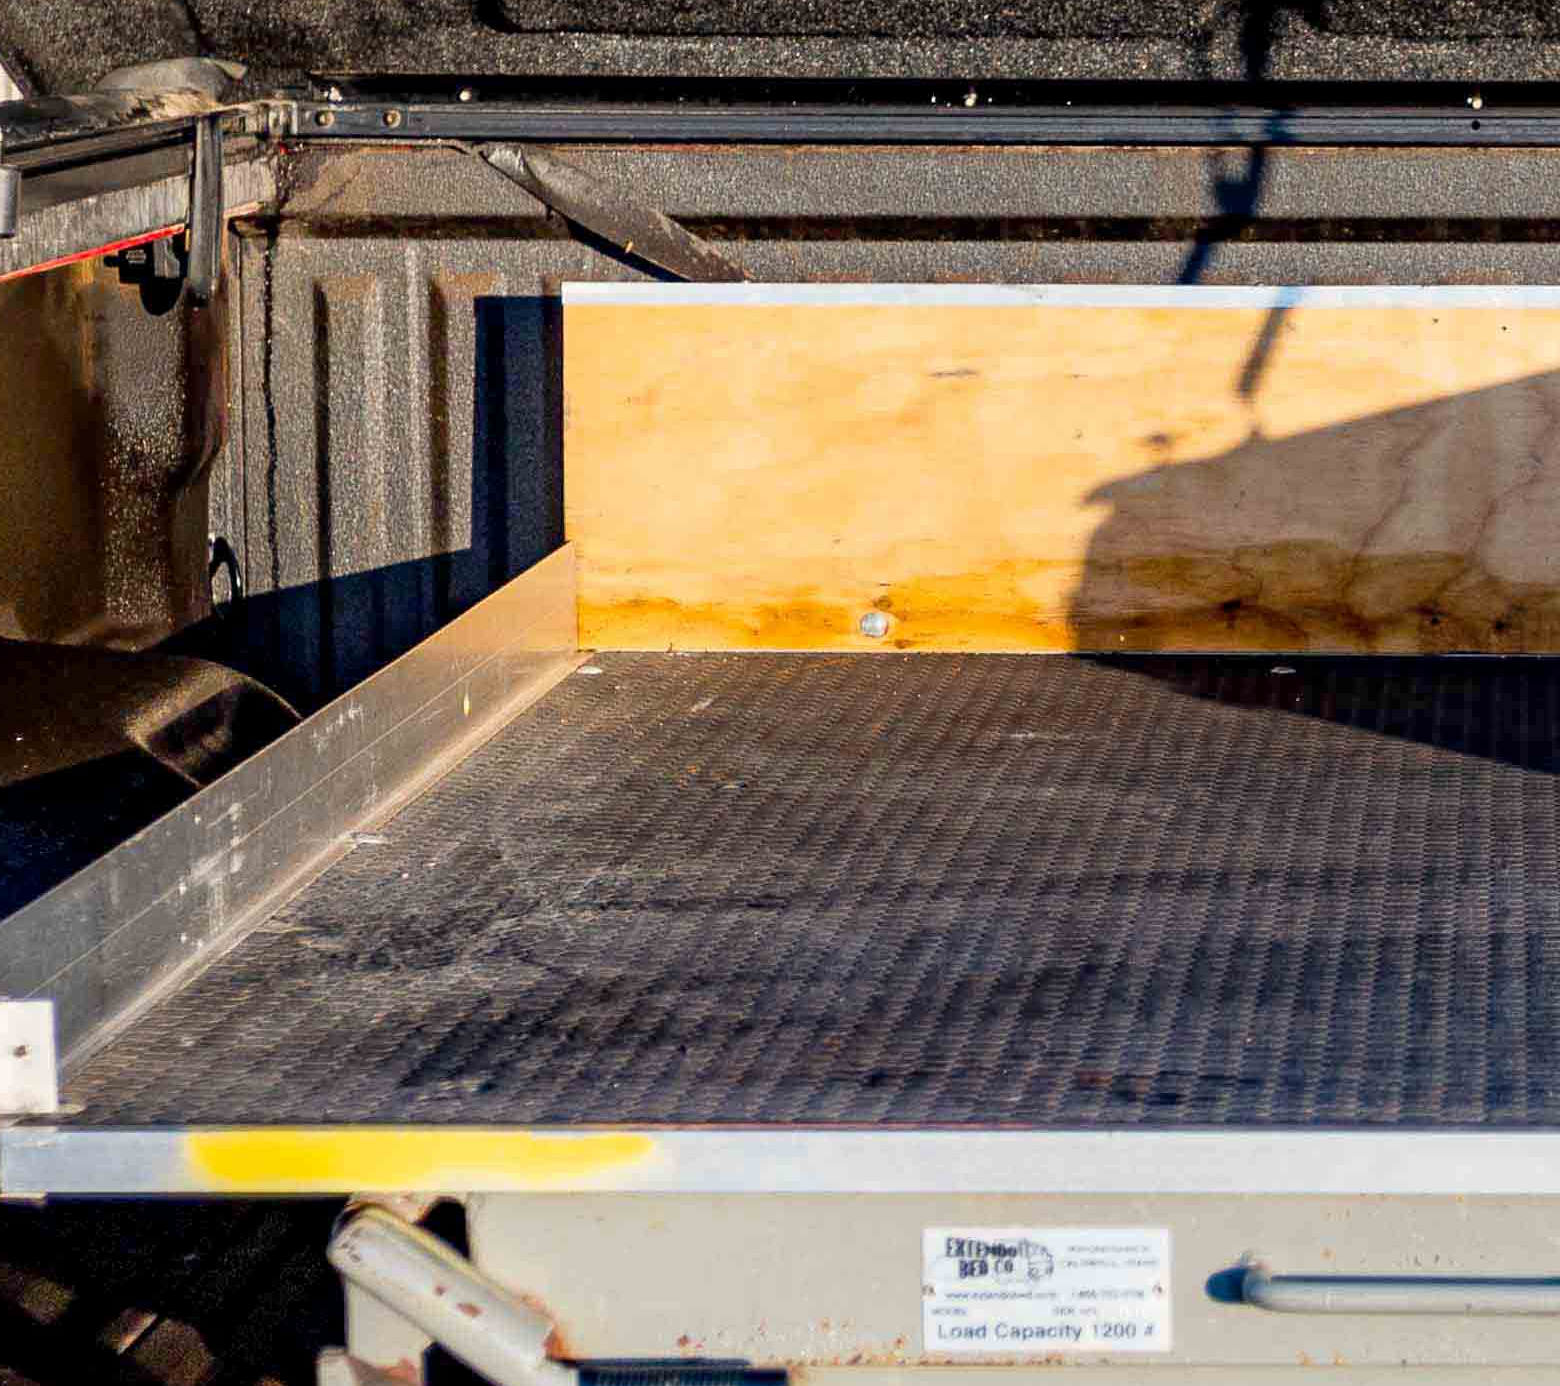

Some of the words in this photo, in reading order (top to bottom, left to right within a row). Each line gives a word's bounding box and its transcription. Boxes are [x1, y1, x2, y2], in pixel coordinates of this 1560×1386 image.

[938, 1324, 987, 1339] Load
[994, 1322, 1082, 1343] Capacity
[1092, 1322, 1137, 1340] 1200
